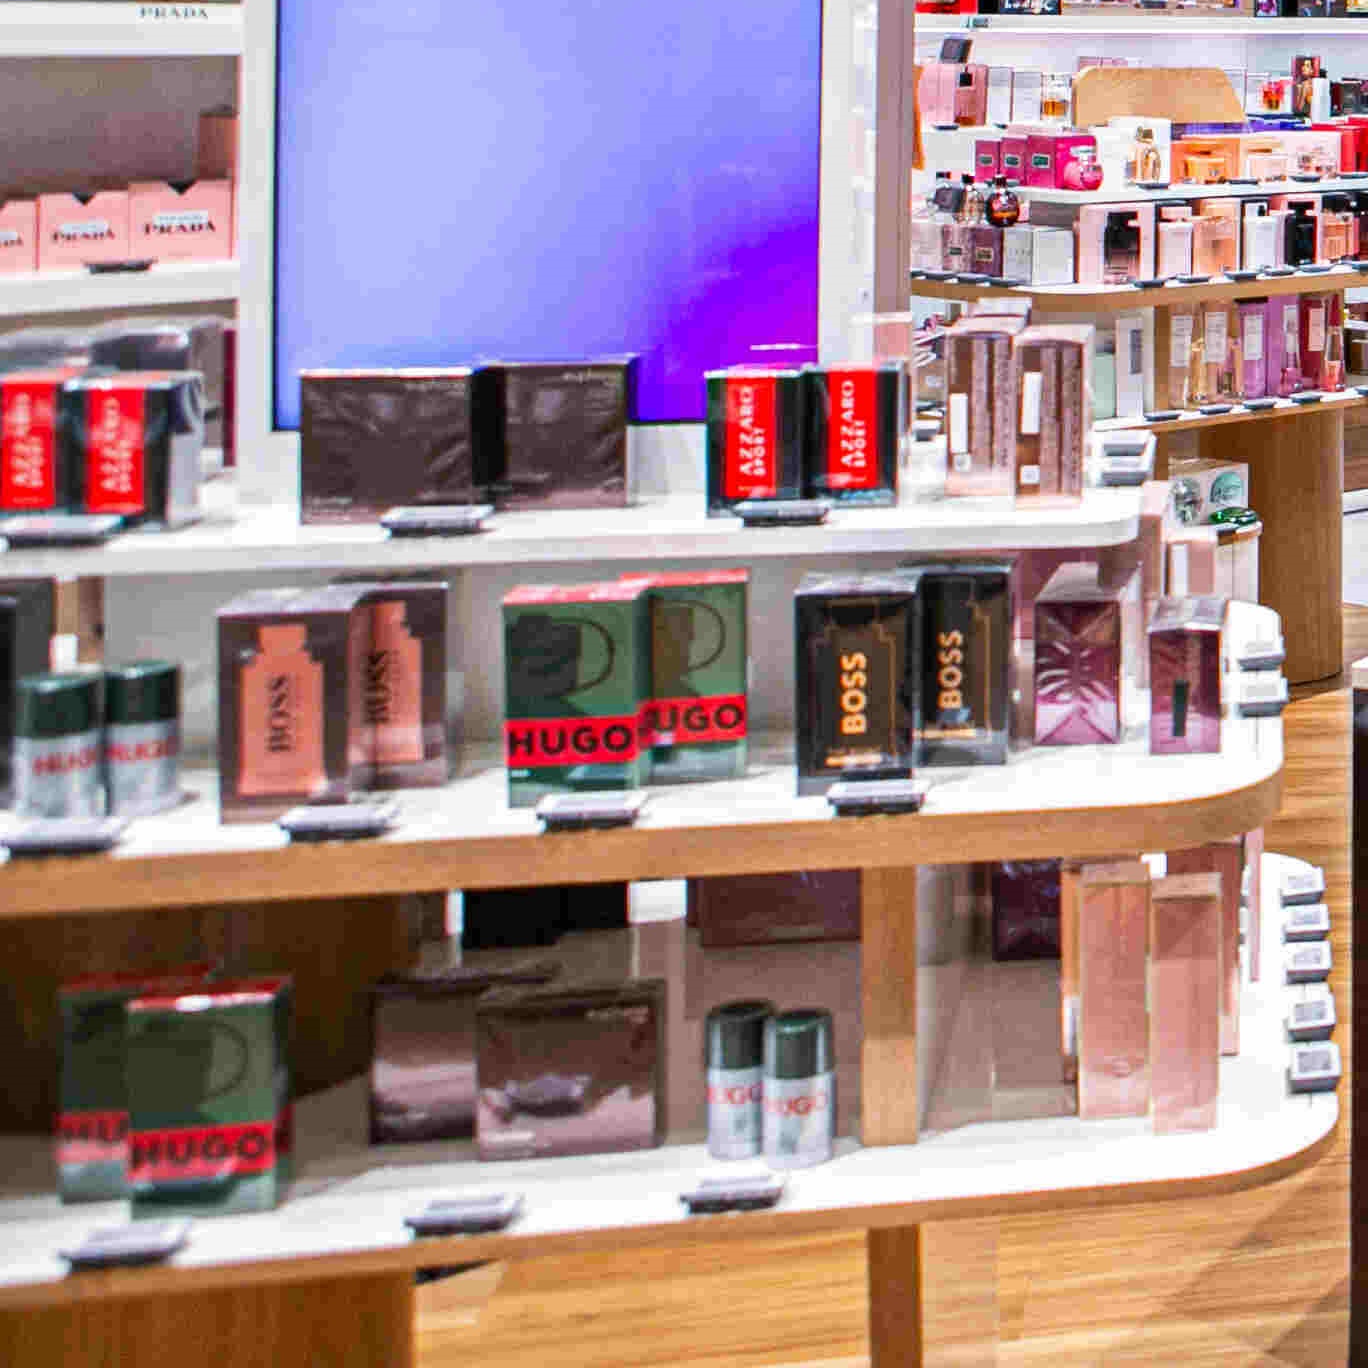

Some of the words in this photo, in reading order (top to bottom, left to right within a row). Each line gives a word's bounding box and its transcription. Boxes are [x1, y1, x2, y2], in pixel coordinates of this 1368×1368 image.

[840, 380, 857, 468] AZZARO
[363, 649, 391, 725] BOSS
[842, 651, 867, 736] BOSS
[938, 630, 964, 709] BOSS
[266, 672, 291, 753] BOSS
[509, 724, 634, 756] HUGO
[655, 702, 744, 732] UGO
[129, 1130, 268, 1173] HUGO
